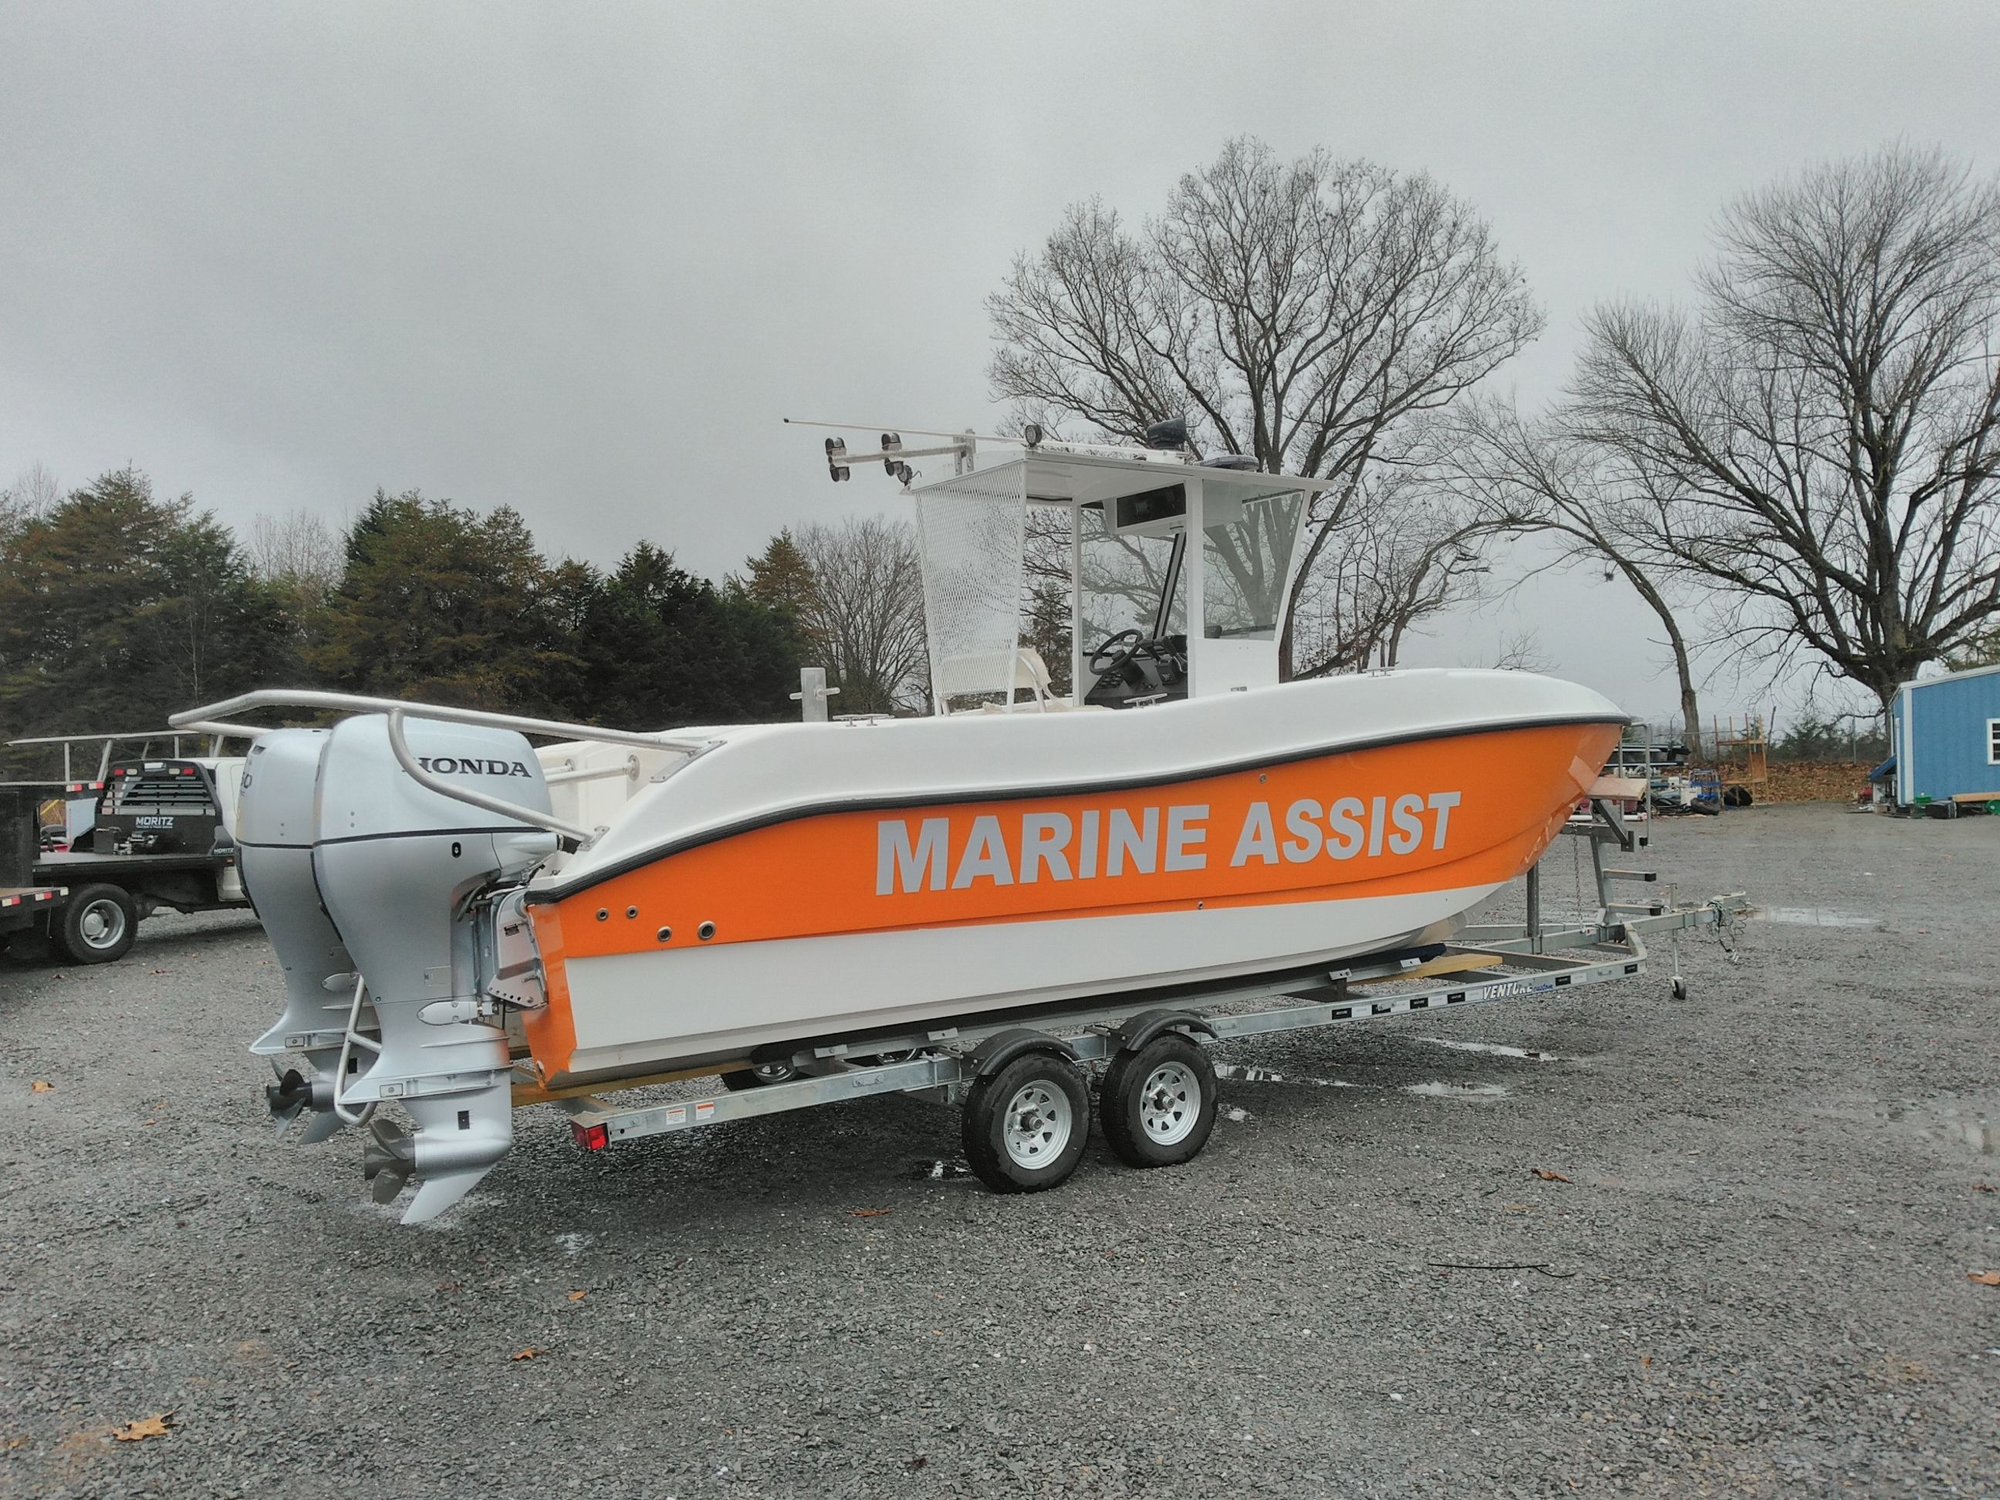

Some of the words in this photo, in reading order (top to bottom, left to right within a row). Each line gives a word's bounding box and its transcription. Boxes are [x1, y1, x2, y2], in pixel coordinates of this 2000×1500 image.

[136, 817, 174, 826] MORITZ
[876, 804, 1210, 896] MARINE
[1230, 791, 1462, 867] ASSIST
